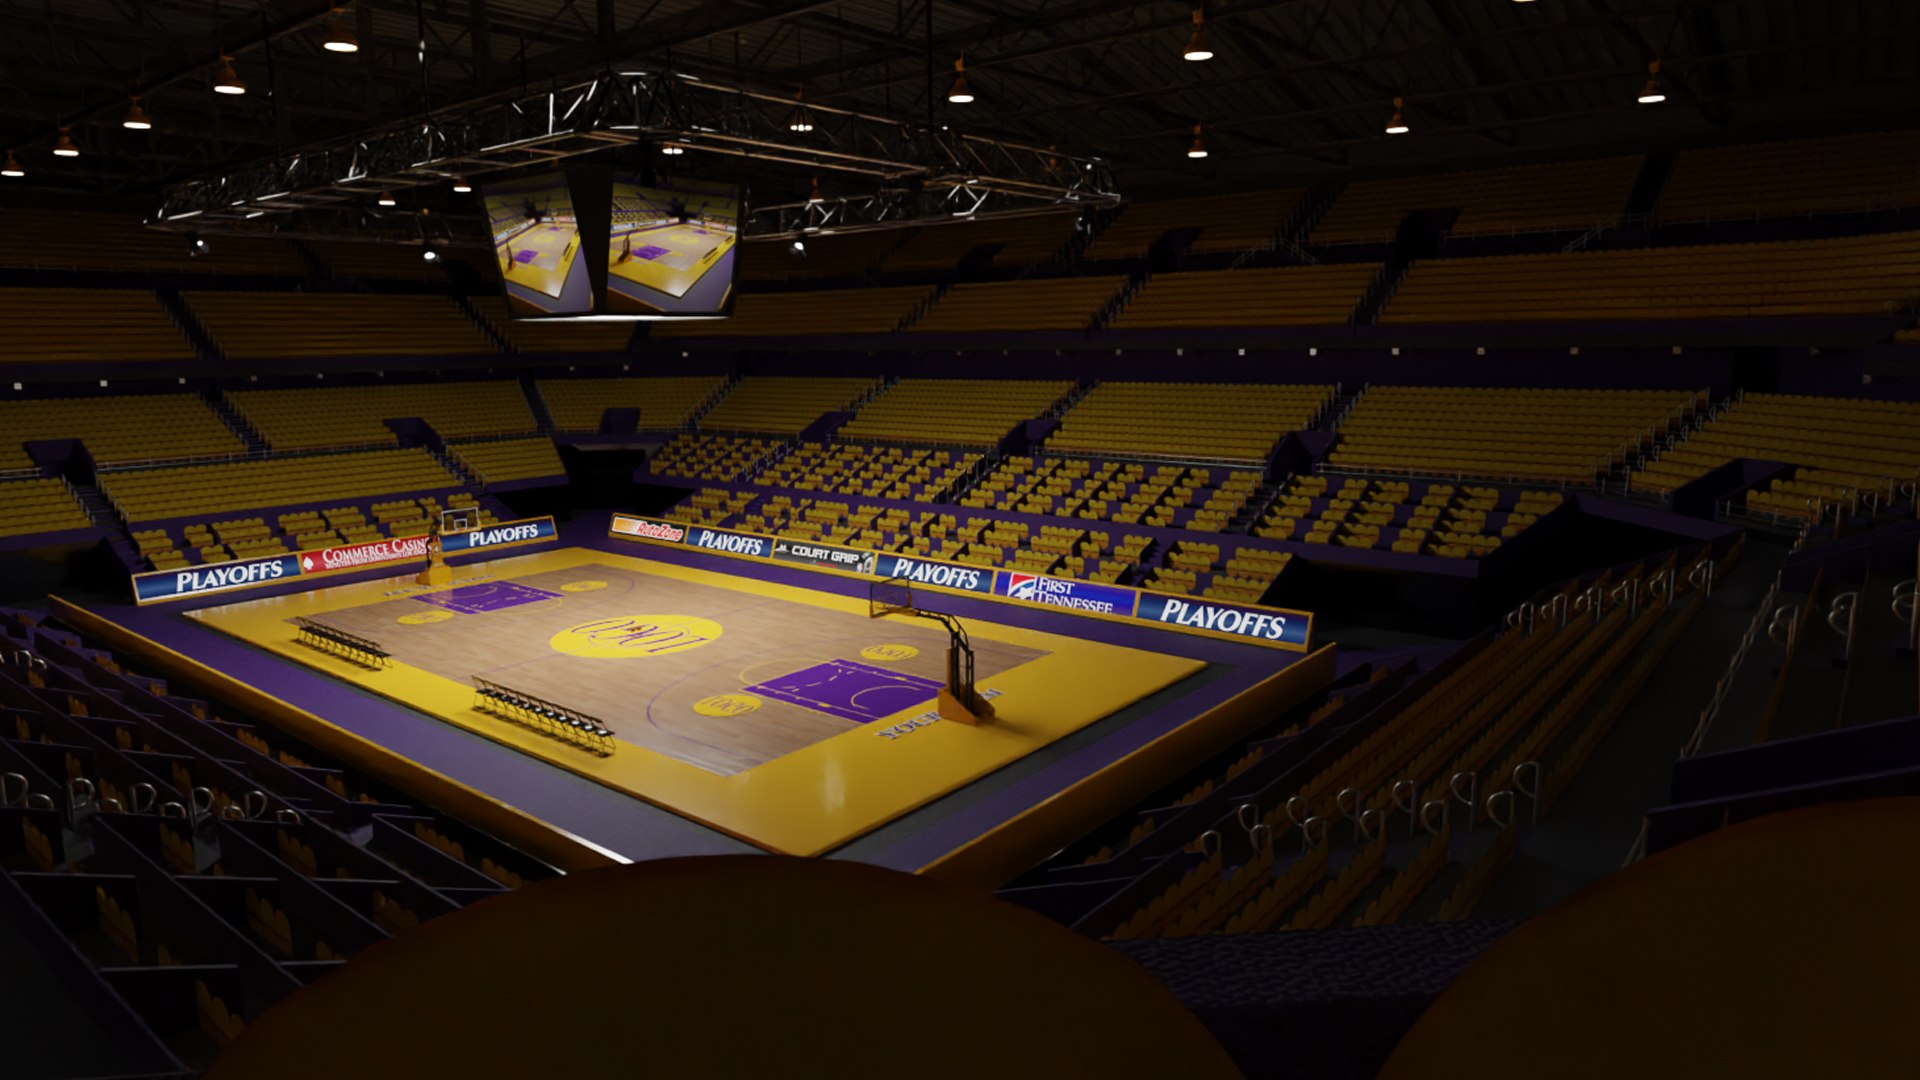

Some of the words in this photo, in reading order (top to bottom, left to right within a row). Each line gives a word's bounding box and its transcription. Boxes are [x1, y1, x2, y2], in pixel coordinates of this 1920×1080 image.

[470, 524, 539, 547] PLAYOFFS
[636, 521, 684, 542] AutoZone
[698, 530, 763, 556] PLAYOFFS
[322, 543, 389, 564] COMMERCE
[791, 545, 830, 561] COURT
[831, 551, 860, 565] GRIP
[176, 560, 284, 592] PLAYOFFS
[892, 558, 980, 590] PLAYOFFS
[1038, 576, 1075, 594] FIRST
[1034, 590, 1113, 614] TENNESSEE
[1160, 598, 1286, 640] PLAYOFFS
